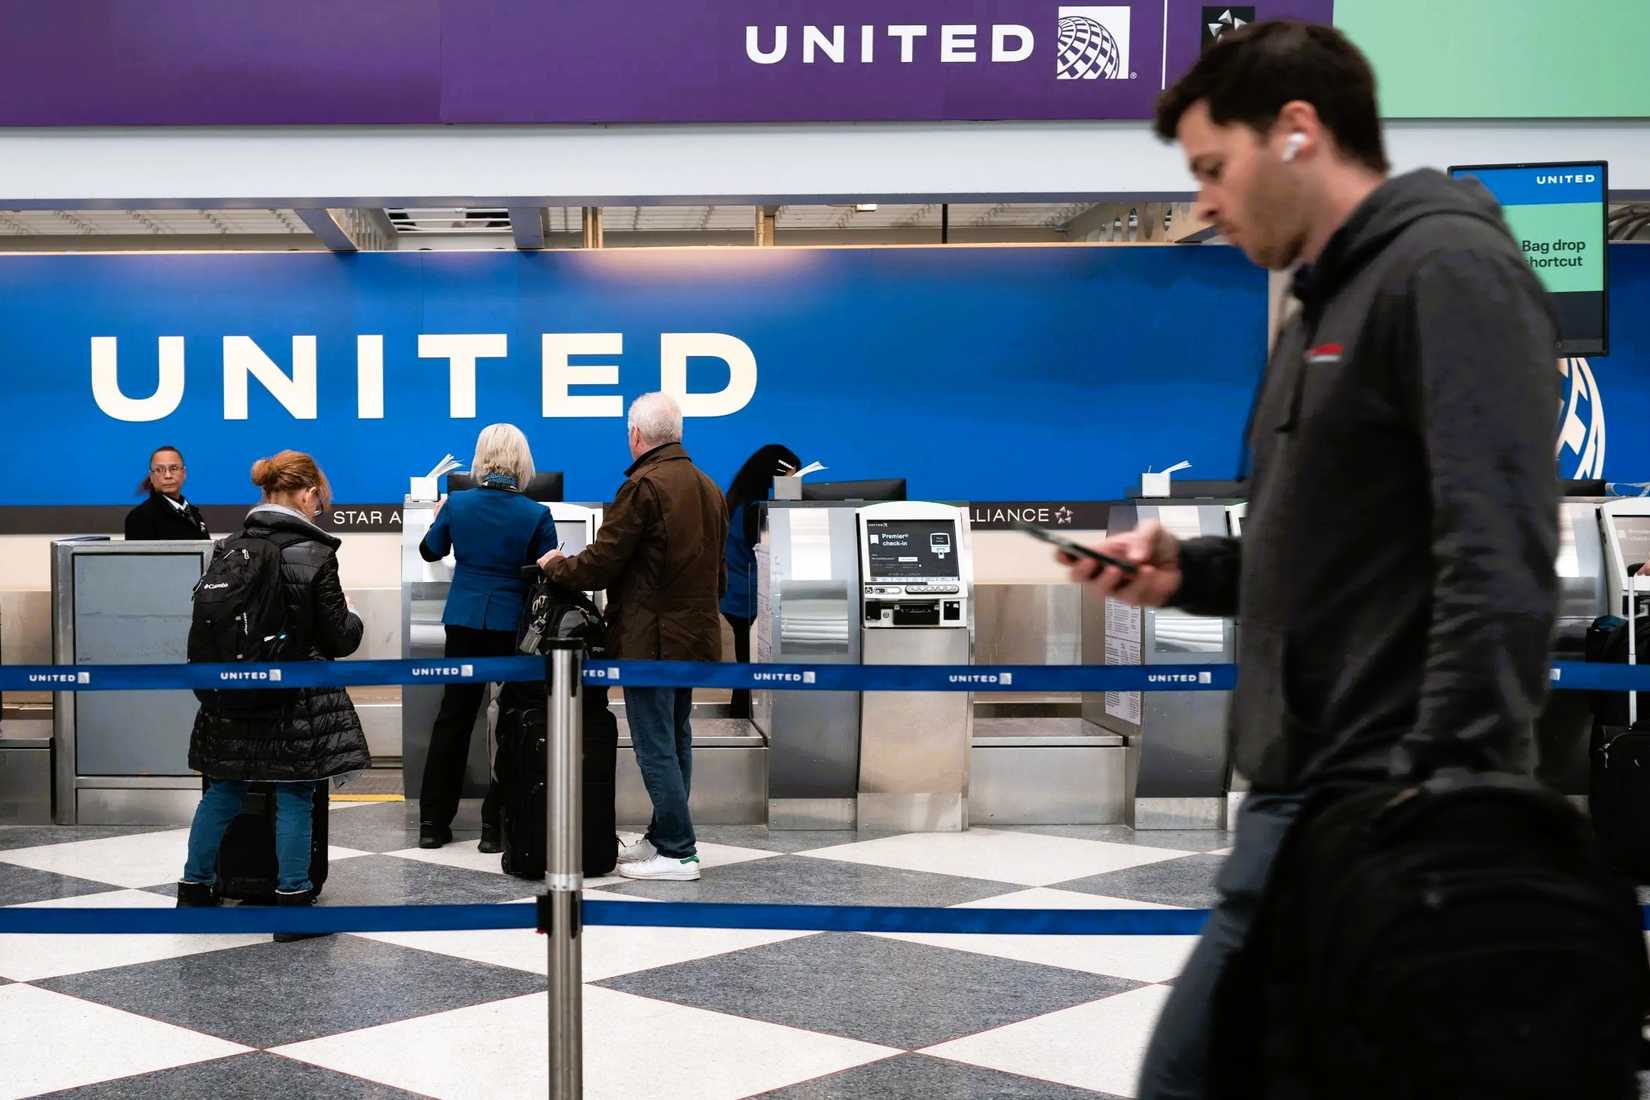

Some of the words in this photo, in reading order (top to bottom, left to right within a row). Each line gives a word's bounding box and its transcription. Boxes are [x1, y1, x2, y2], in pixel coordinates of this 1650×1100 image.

[745, 24, 1035, 65] UNITED
[1536, 174, 1596, 185] UNITED
[1521, 240, 1549, 255] Bag
[1552, 239, 1586, 254] drop
[1528, 256, 1583, 268] hortcut
[91, 332, 757, 422] UNITED
[333, 510, 383, 525] STAR
[389, 510, 402, 525] A
[970, 508, 1049, 523] LIANCE
[220, 671, 268, 680] UNITED
[412, 667, 460, 676] UNITED
[582, 669, 606, 678] TED
[29, 674, 77, 682] UNITED
[753, 672, 802, 682] UNITED
[949, 674, 998, 683] UNITED
[1148, 674, 1198, 683] UNITED
